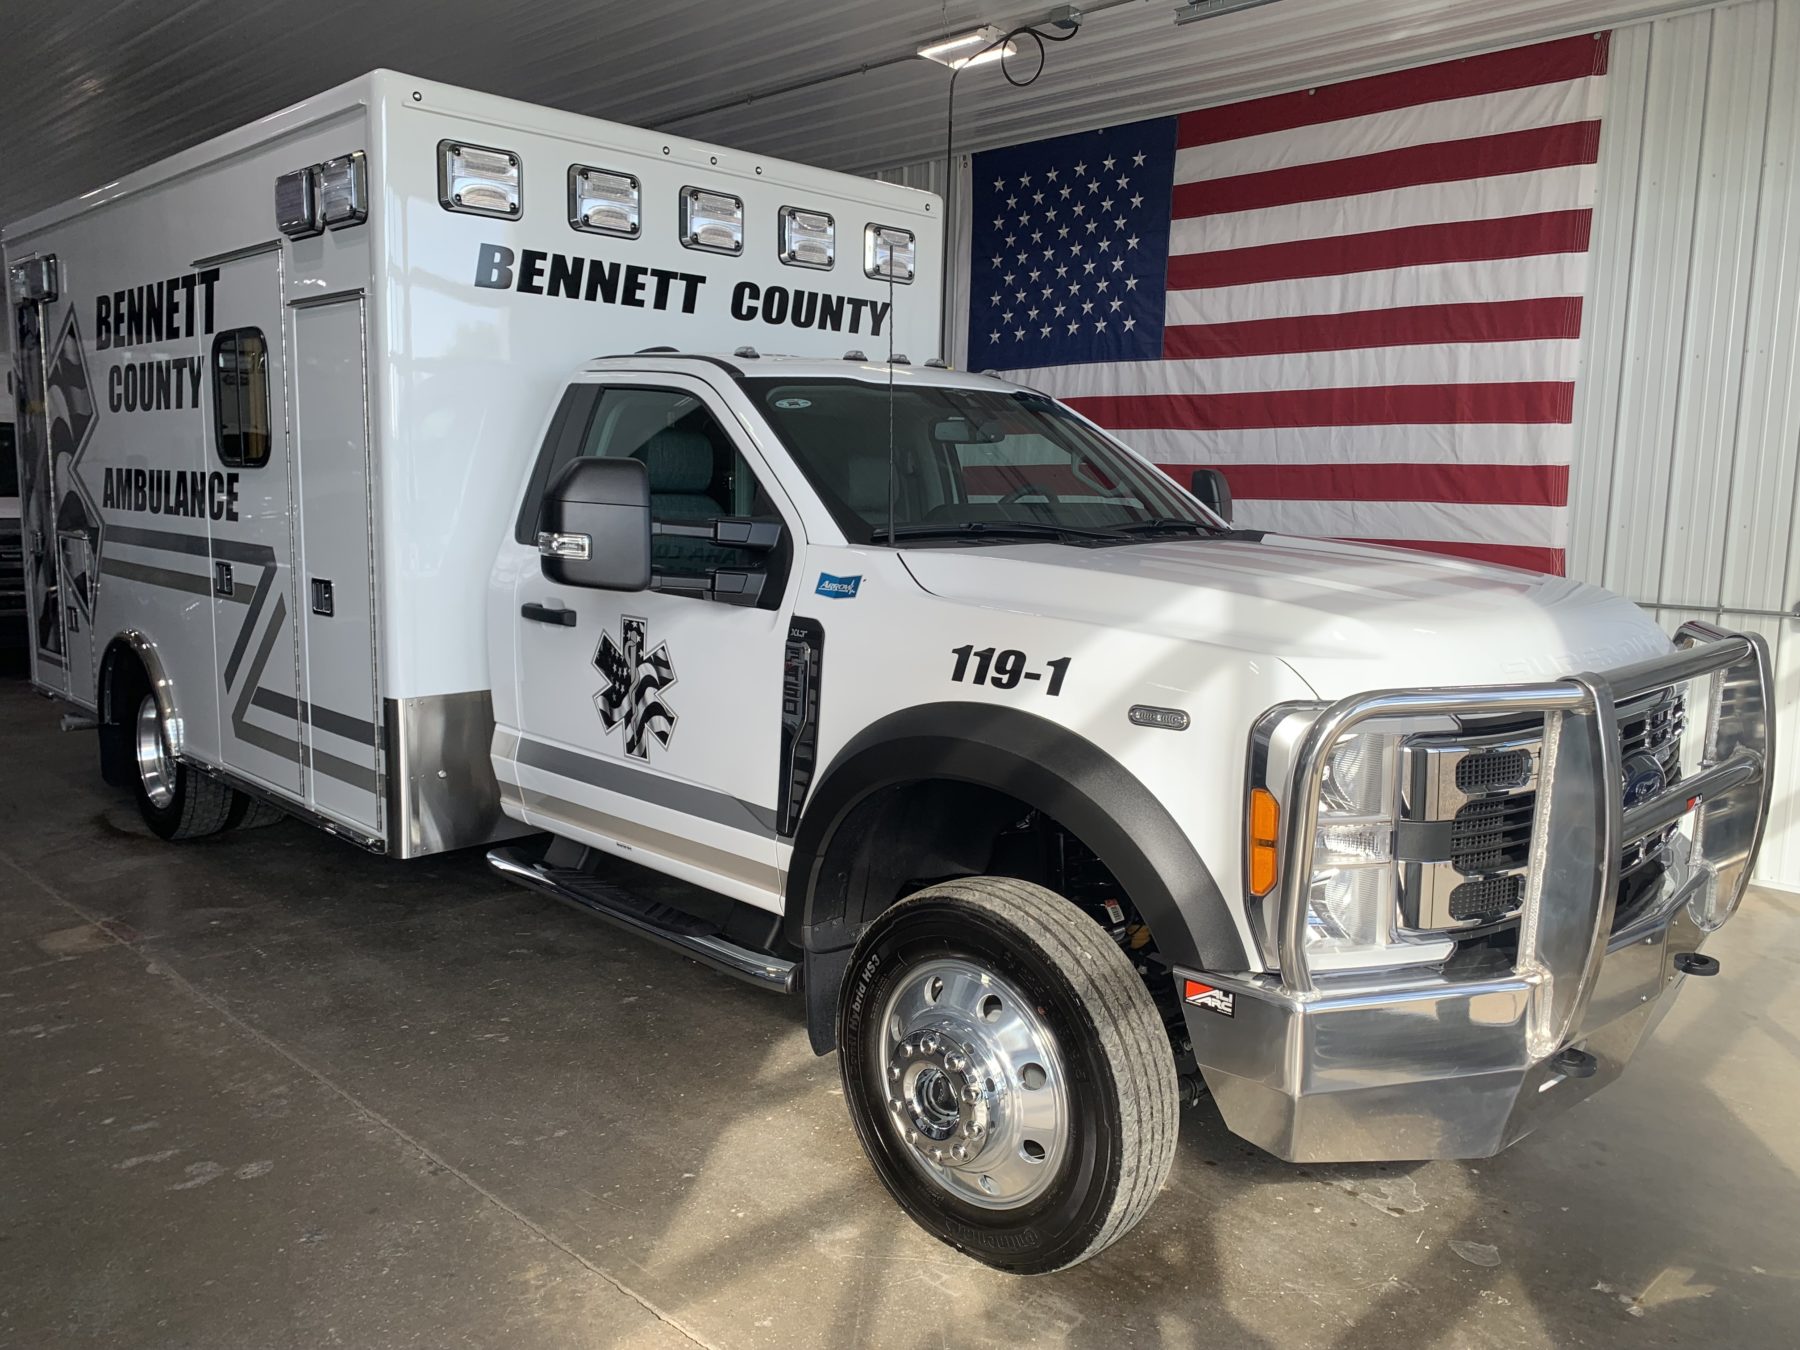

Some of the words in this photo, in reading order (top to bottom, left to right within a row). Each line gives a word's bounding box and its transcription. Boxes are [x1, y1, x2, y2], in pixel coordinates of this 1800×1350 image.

[96, 267, 221, 351] BENNETT
[473, 242, 706, 314] BENNETT
[730, 281, 891, 337] COUNTY
[108, 355, 205, 413] COUNTY
[102, 467, 240, 523] AMBULANCE
[790, 628, 808, 638] XLT
[951, 644, 1072, 697] 119-1
[861, 954, 880, 982] HS3
